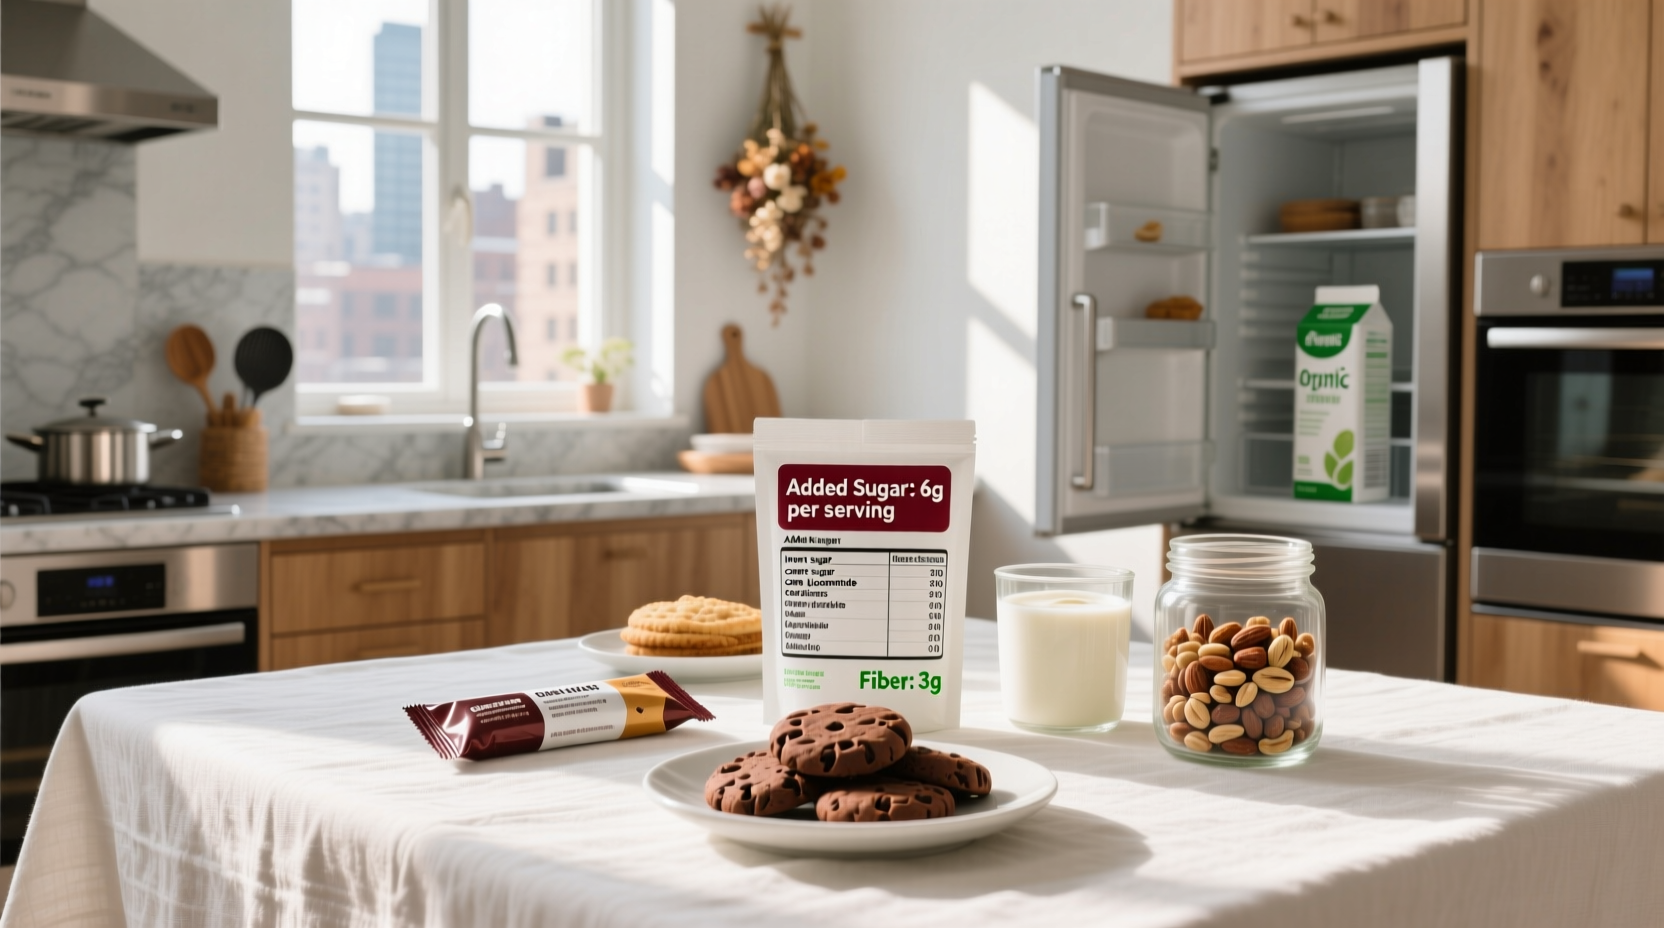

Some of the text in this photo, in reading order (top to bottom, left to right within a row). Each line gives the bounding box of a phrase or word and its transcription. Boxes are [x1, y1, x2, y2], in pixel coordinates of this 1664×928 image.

[786, 478, 944, 502] Added Sugar: 6g
[787, 501, 895, 523] per serving
[859, 670, 942, 695] Fiber: 3g
